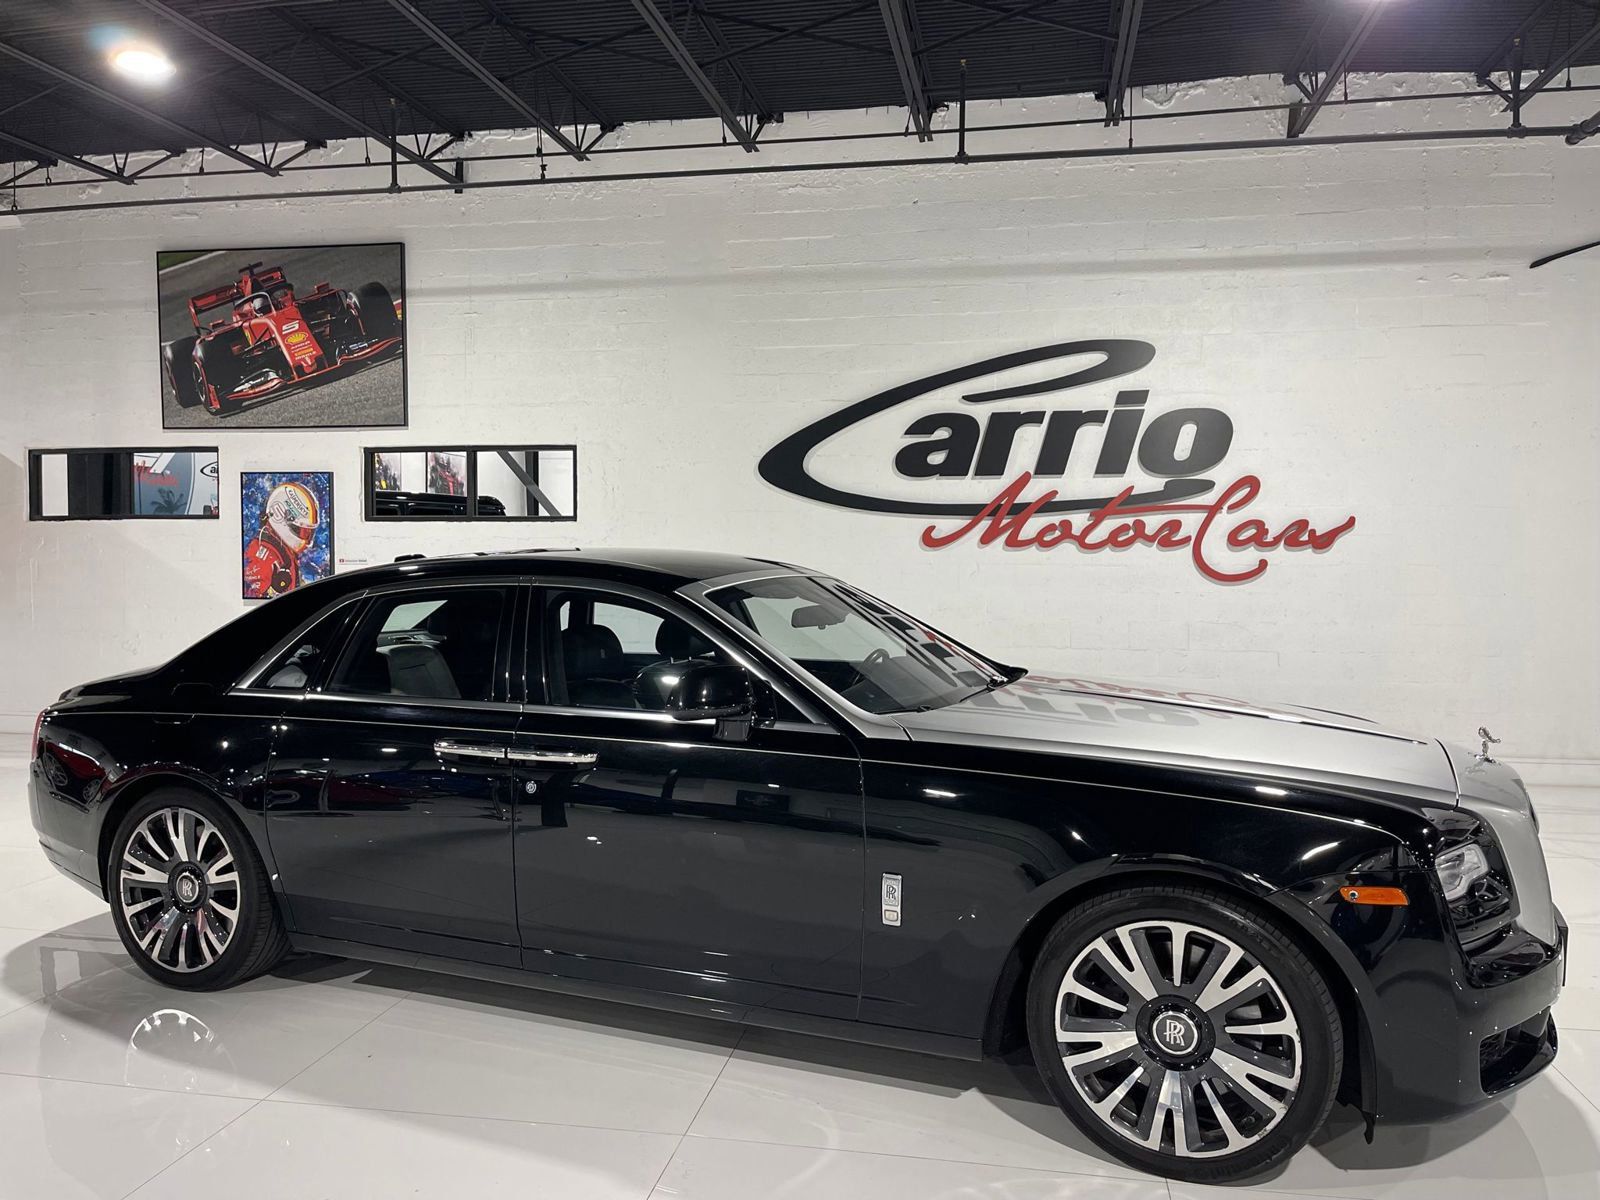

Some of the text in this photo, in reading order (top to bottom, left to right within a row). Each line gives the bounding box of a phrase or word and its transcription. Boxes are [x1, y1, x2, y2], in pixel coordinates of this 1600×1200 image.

[282, 320, 299, 335] 5
[758, 339, 1234, 516] Carrio
[1163, 1019, 1185, 1046] RR
